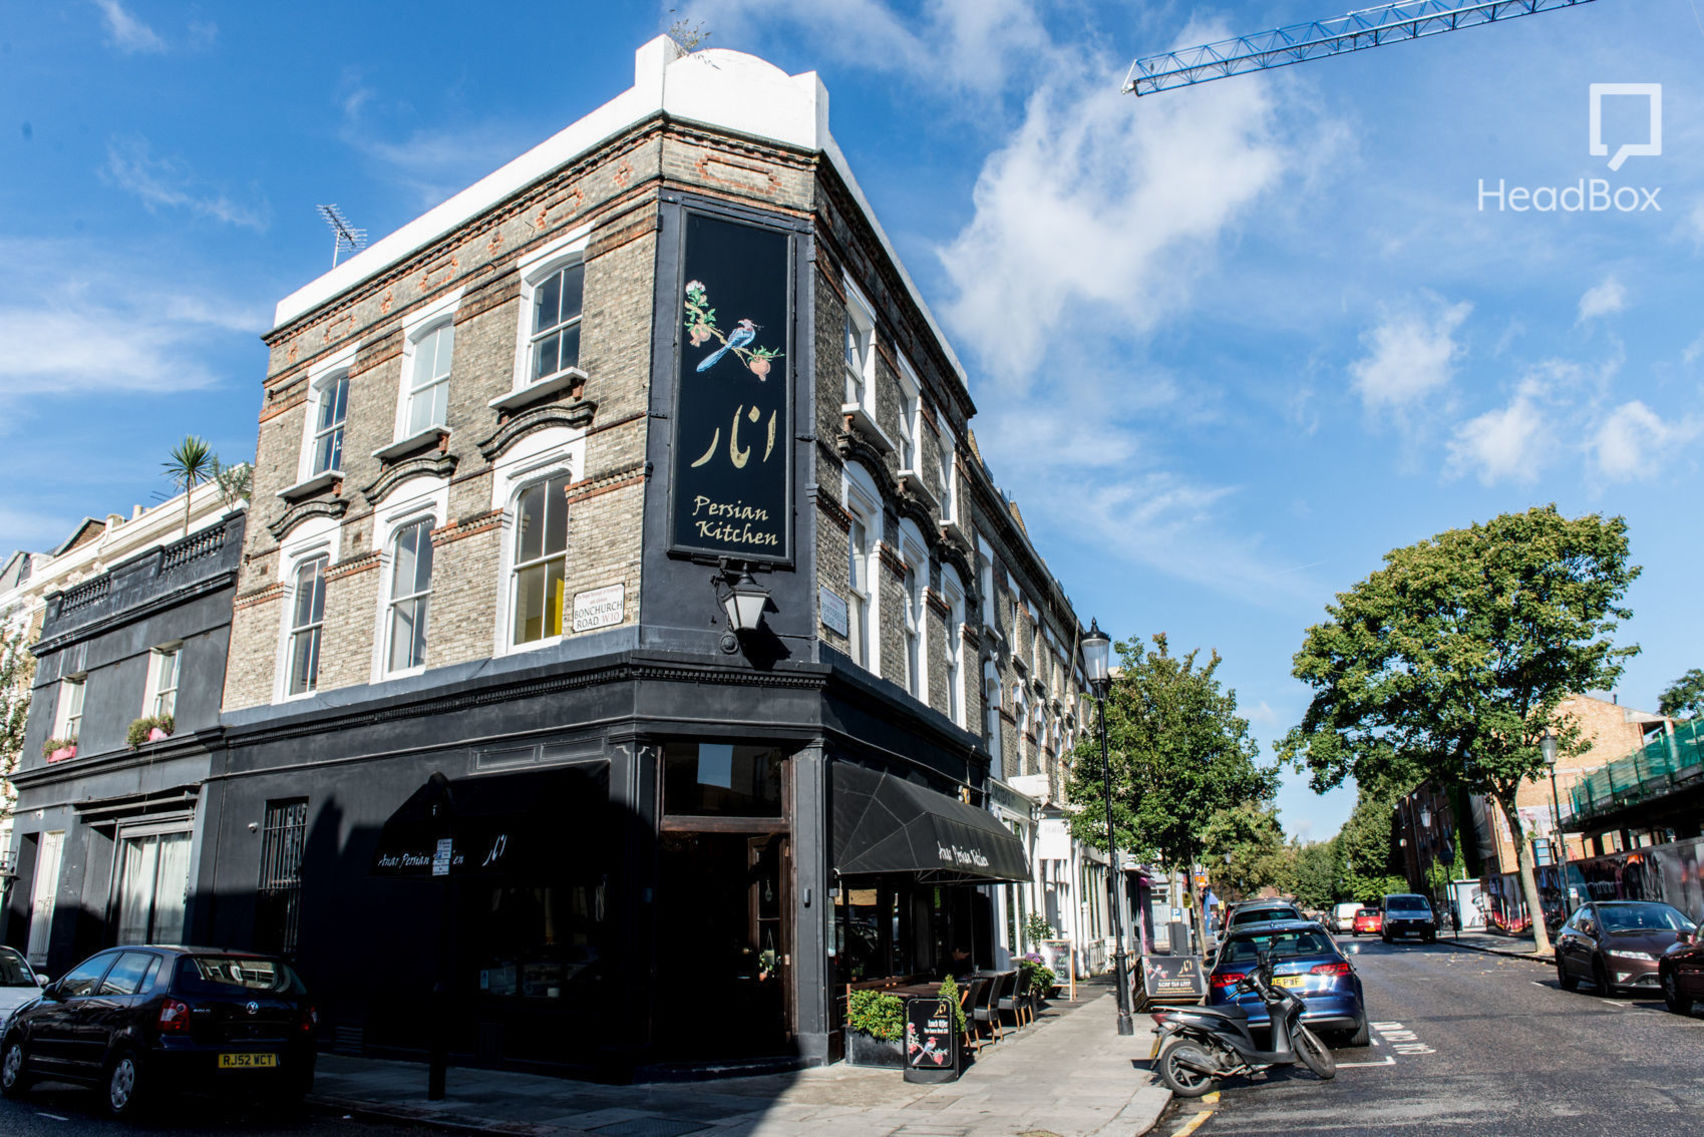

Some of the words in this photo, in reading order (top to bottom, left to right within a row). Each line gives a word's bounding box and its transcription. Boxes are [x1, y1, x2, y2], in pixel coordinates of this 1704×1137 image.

[692, 495, 769, 521] Persian
[695, 520, 779, 546] Kitchen
[575, 600, 623, 619] BONCHURCH
[576, 616, 599, 629] ROAD
[223, 1054, 251, 1066] RJ52
